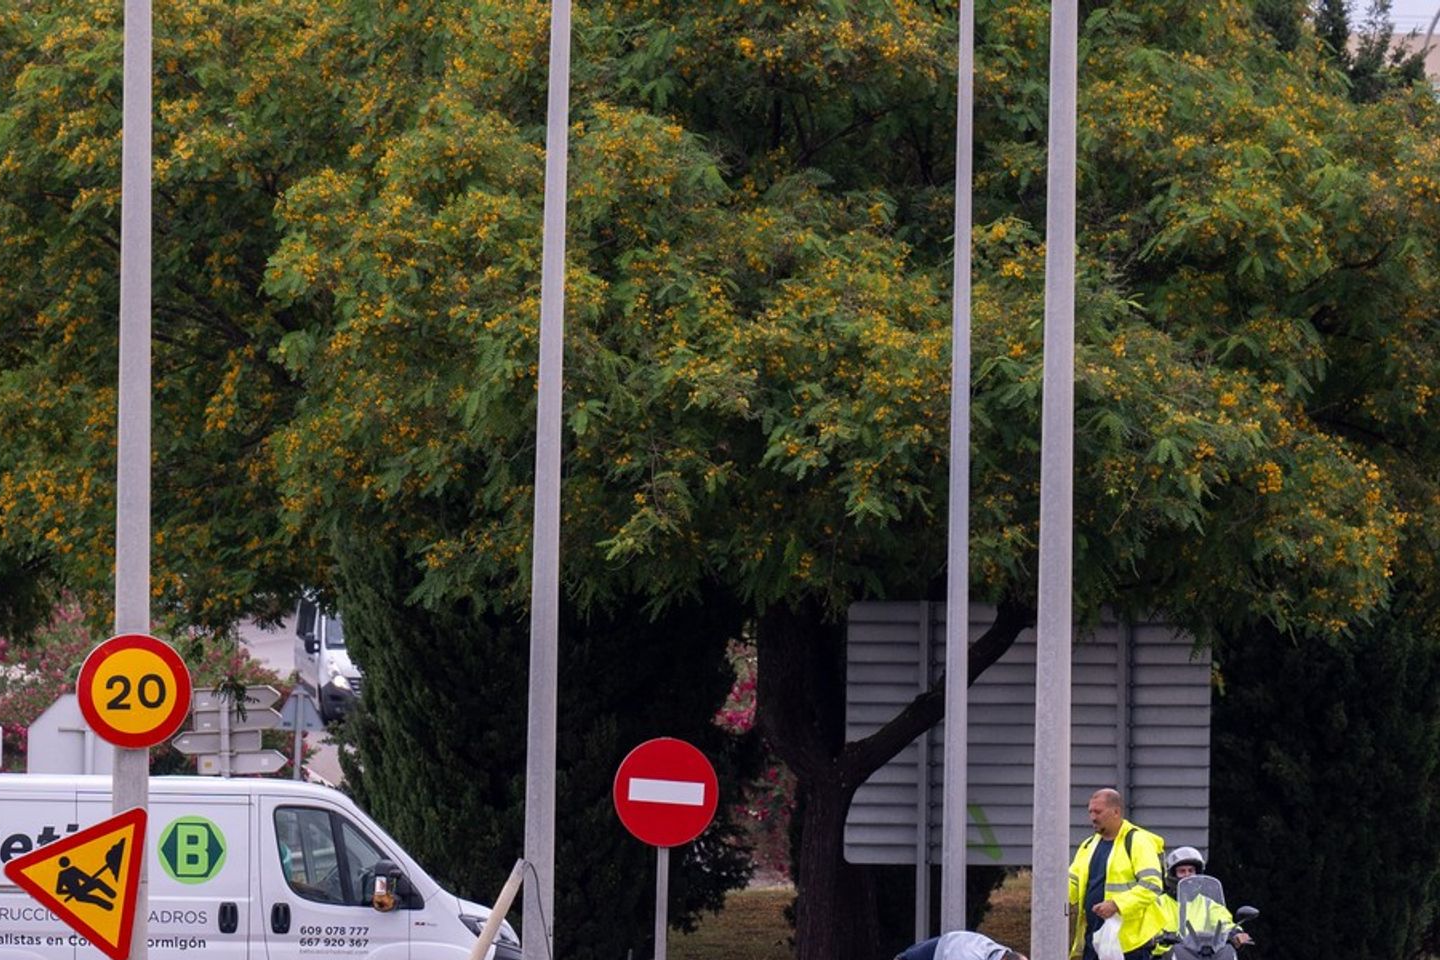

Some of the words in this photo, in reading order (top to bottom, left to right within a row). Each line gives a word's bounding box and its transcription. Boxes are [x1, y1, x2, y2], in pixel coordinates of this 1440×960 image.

[105, 674, 166, 710] 20
[177, 825, 209, 875] B
[147, 910, 208, 925] ADROS
[300, 926, 322, 936] 609
[325, 926, 346, 936] 078
[349, 926, 369, 936] 777
[46, 936, 64, 945] en
[147, 935, 206, 950] ormigón
[299, 937, 321, 947] 667
[323, 937, 346, 947] 920
[348, 938, 369, 948] 367
